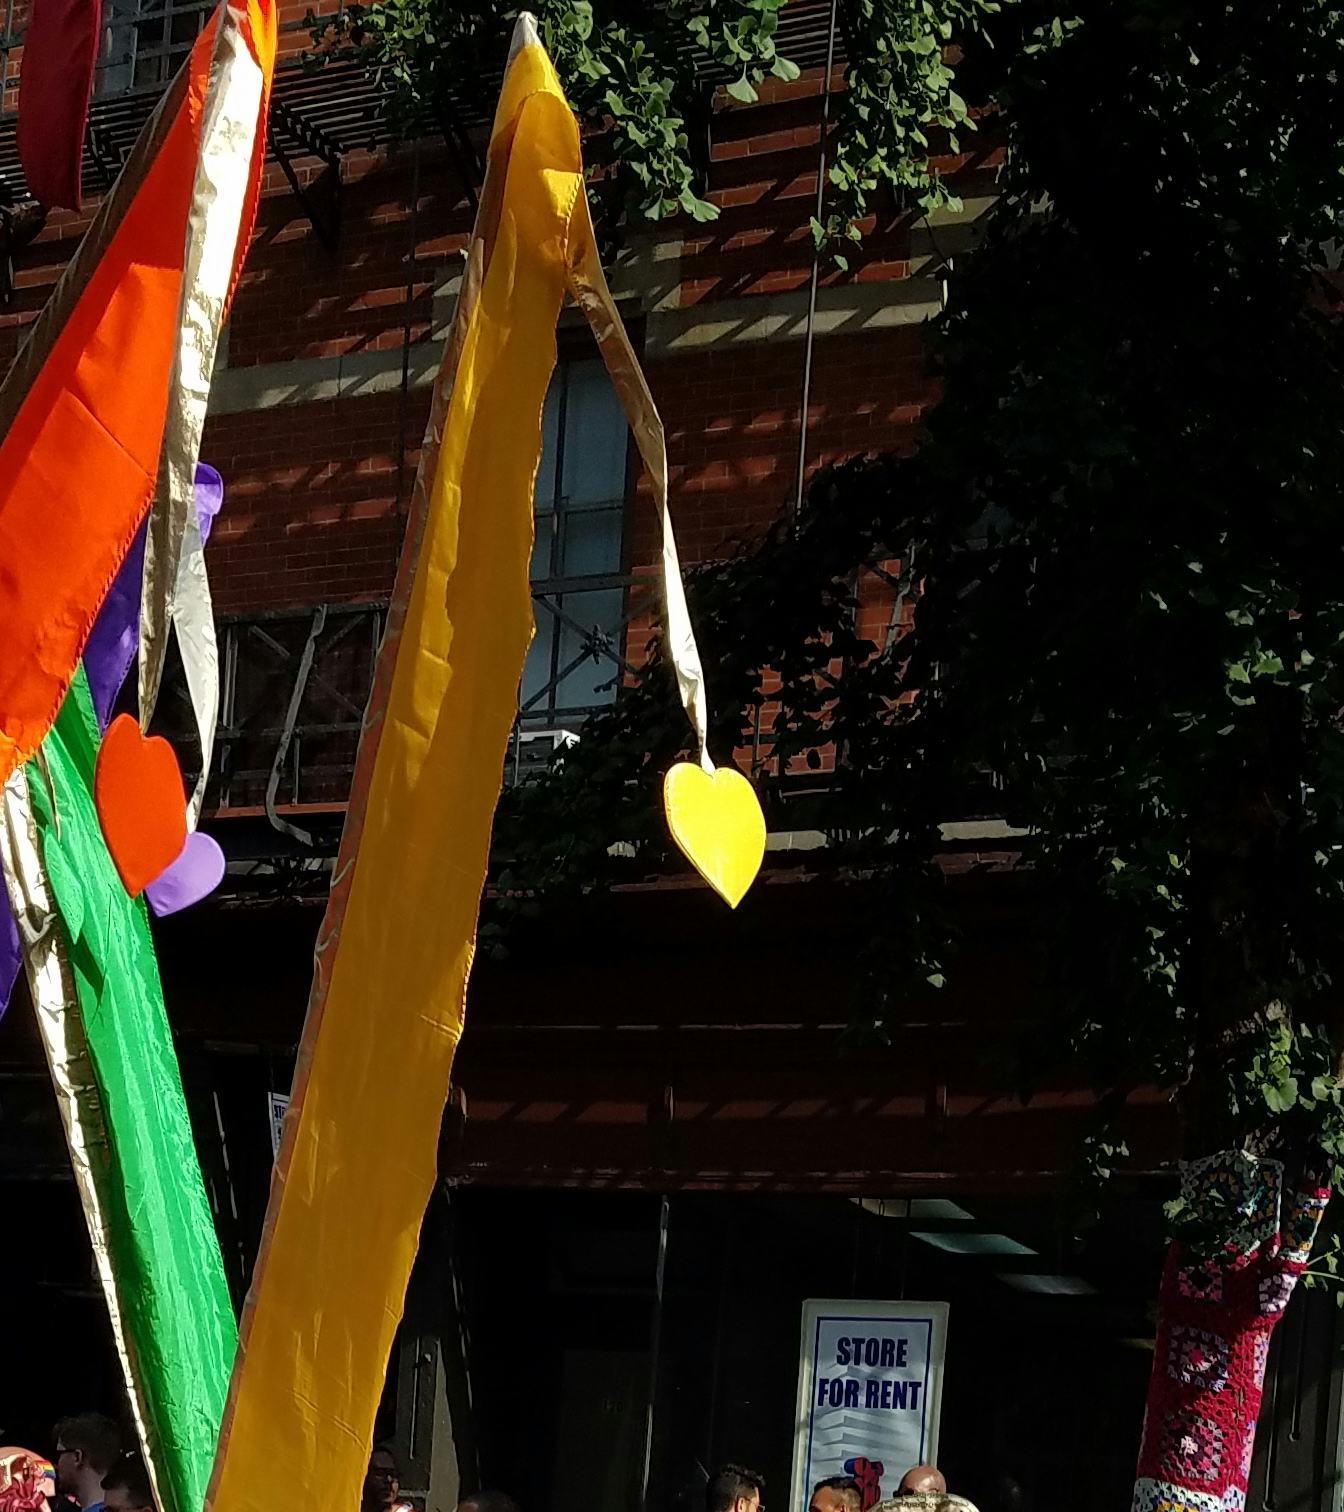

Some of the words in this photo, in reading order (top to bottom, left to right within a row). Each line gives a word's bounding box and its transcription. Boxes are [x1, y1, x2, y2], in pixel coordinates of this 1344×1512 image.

[836, 1337, 907, 1368] STORE
[818, 1377, 860, 1408] FOR
[865, 1379, 922, 1410] RENT
